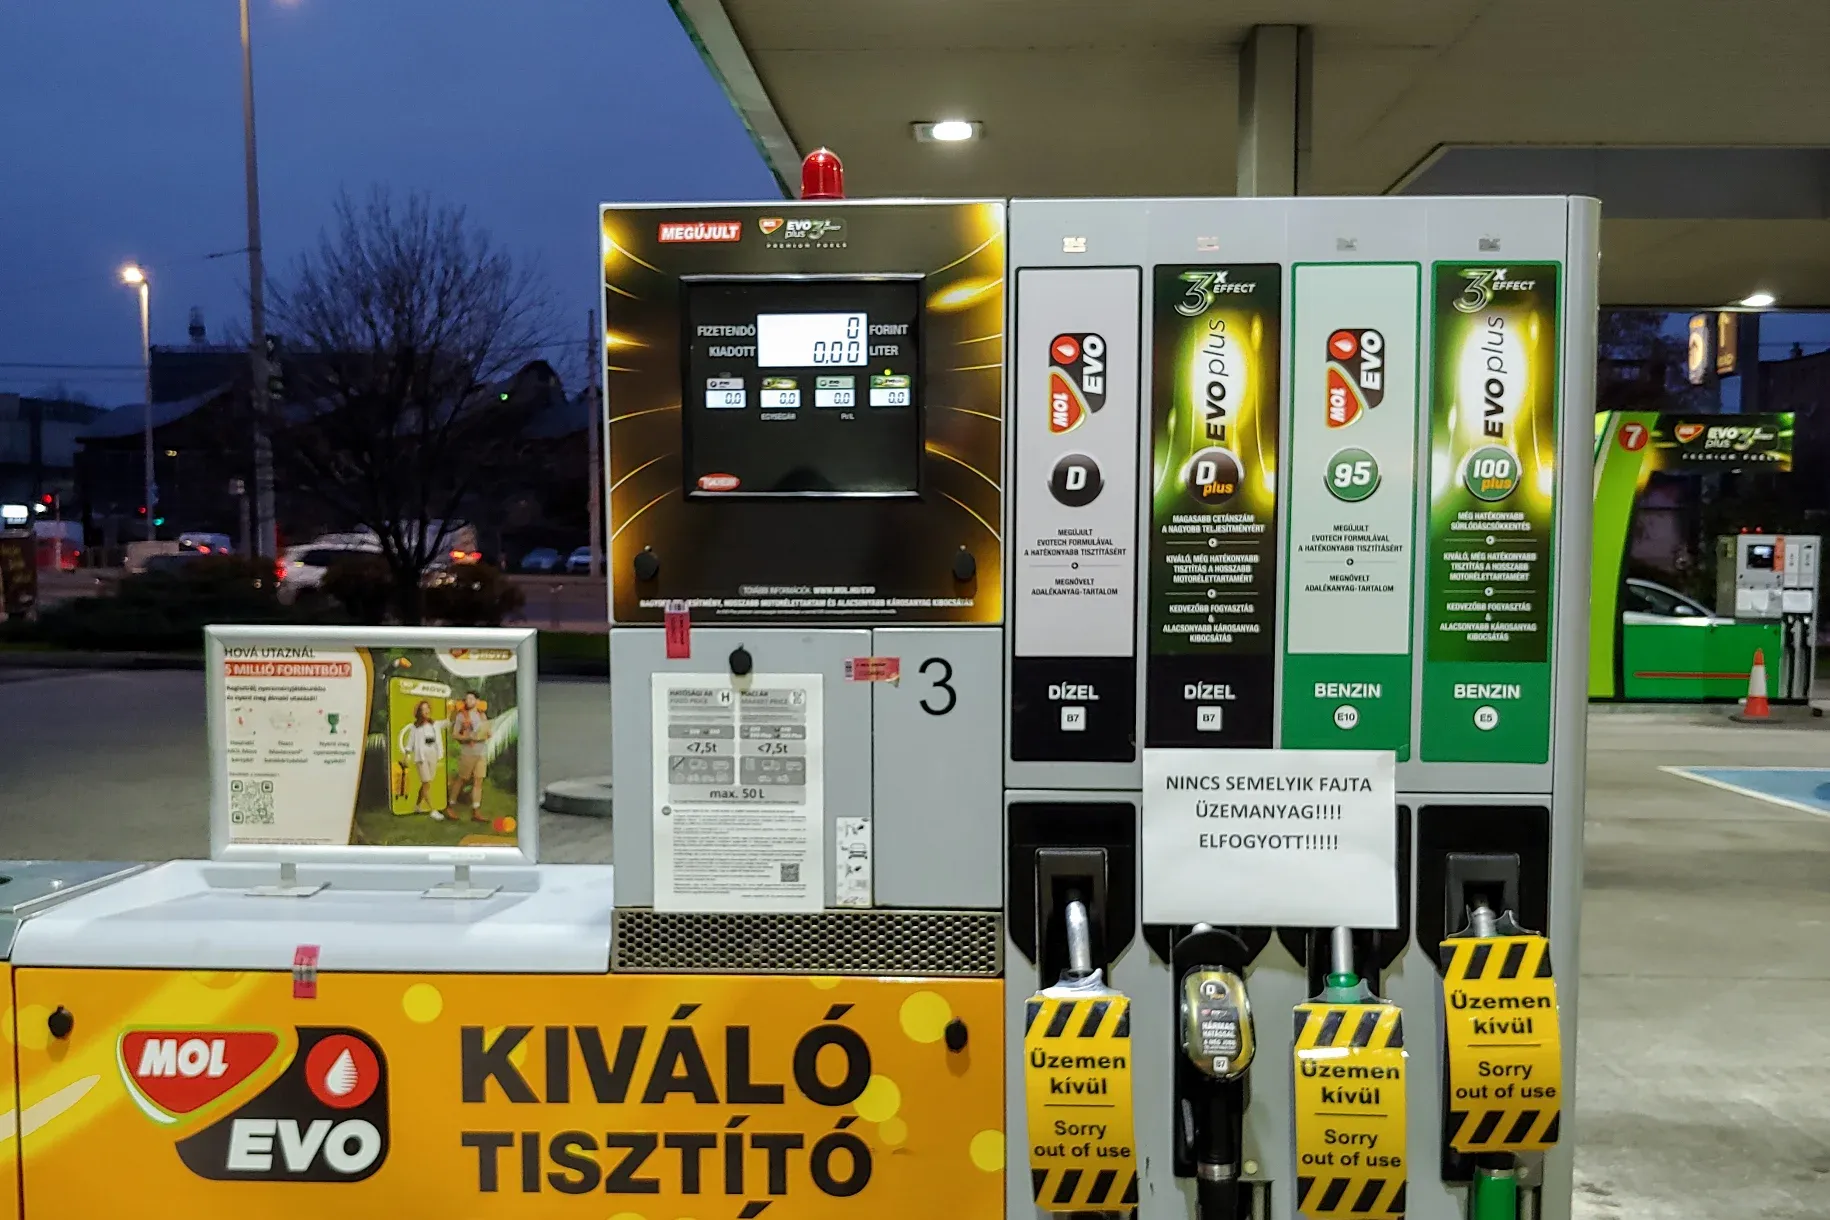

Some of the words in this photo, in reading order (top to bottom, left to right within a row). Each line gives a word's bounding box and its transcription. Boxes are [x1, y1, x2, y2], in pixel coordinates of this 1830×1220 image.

[661, 223, 739, 241] MEGÚJULT
[1213, 283, 1256, 294] EFFECT
[1492, 280, 1536, 291] EFFECT
[869, 324, 909, 336] FORINT
[709, 346, 756, 357] KIADOTT
[869, 345, 899, 356] LITER
[1052, 392, 1069, 428] MOL
[1082, 334, 1105, 395] EVO
[1330, 387, 1348, 423] MOL
[1360, 330, 1384, 391] EVO
[1624, 425, 1644, 448] 7
[1707, 426, 1739, 440] EVO
[1196, 460, 1218, 486] D
[1334, 461, 1372, 488] 95
[1473, 459, 1510, 479] 100
[1065, 466, 1087, 491] D
[1481, 478, 1512, 492] plus
[1203, 481, 1234, 497] plus
[1068, 536, 1113, 546] FORMULÁVAL
[1210, 602, 1254, 613] FOGYASZTÁS
[225, 646, 258, 658] HOVÁ
[233, 662, 275, 676] MILLIÓ
[277, 662, 350, 677] FORINTBÓL?
[918, 657, 957, 716] 3
[1048, 681, 1099, 700] DÍZEL
[1184, 681, 1237, 700] DÍZEL
[1314, 682, 1382, 698] BENZIN
[1454, 684, 1521, 700] BENZIN
[721, 692, 730, 702] H
[1066, 714, 1080, 722] B7
[1202, 714, 1216, 722] B7
[1336, 712, 1356, 722] E10
[1480, 713, 1493, 723] E5
[686, 742, 717, 754] <7,5t
[758, 743, 788, 756] <7,5t
[1166, 776, 1220, 792] NINCS
[1226, 776, 1314, 792] SEMELYIK
[1319, 777, 1372, 792] FAJTA
[710, 789, 738, 798] max.
[742, 788, 757, 798] 50
[1196, 800, 1342, 820] ÜZEMANYAG!!!!
[1199, 834, 1339, 850] ELFOGYOTT!!!!!
[1450, 989, 1552, 1010] Üzemen
[1473, 1018, 1533, 1035] kívül
[136, 1038, 229, 1078] MOL
[460, 1003, 872, 1107] KIVÁLÓ
[1030, 1048, 1126, 1069] Üzemen
[1301, 1058, 1400, 1080] Üzemen
[1478, 1061, 1533, 1080] Sorry
[1050, 1077, 1108, 1096] kívül
[1321, 1085, 1380, 1105] kívül
[1455, 1086, 1488, 1099] out
[1494, 1083, 1515, 1098] of
[1521, 1086, 1557, 1098] use
[1054, 1120, 1107, 1140] Sorry
[226, 1117, 382, 1174] EVO
[1324, 1129, 1378, 1149] Sorry
[461, 1115, 872, 1198] TISZTÍTÓ
[1034, 1145, 1065, 1158] out
[1071, 1142, 1092, 1158] of
[1096, 1146, 1131, 1158] use
[1302, 1152, 1333, 1166] out
[1340, 1151, 1362, 1166] of
[1366, 1155, 1402, 1168] use
